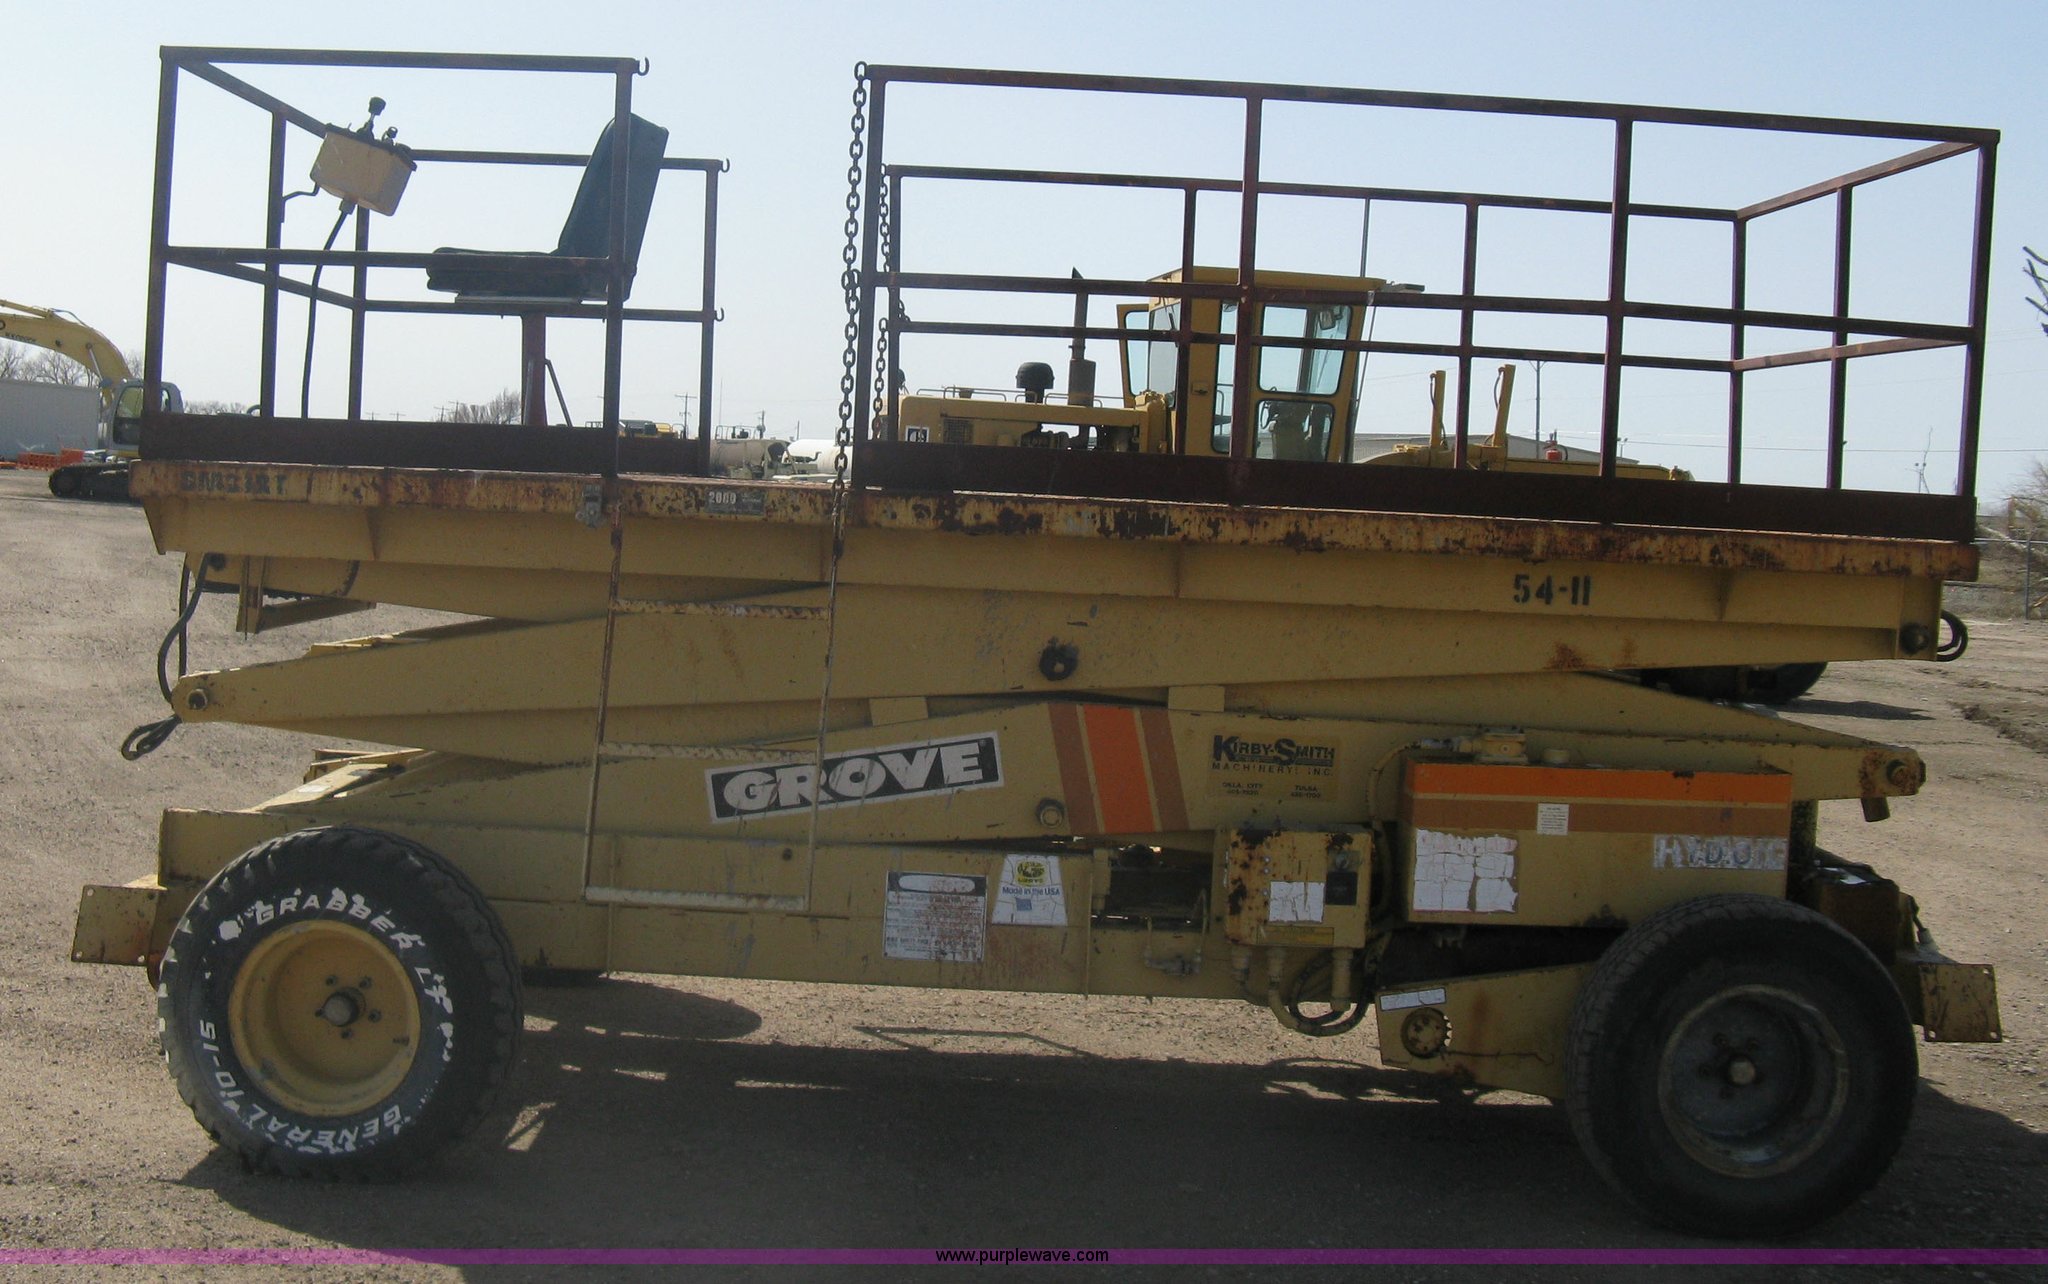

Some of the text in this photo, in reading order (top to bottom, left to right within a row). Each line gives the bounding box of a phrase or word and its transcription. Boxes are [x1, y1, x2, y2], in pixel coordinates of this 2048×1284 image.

[724, 742, 984, 811] GROVE
[246, 887, 426, 950] GRABBER
[1002, 886, 1022, 895] Made
[1044, 888, 1060, 896] USA
[249, 1103, 412, 1155] GENERAL
